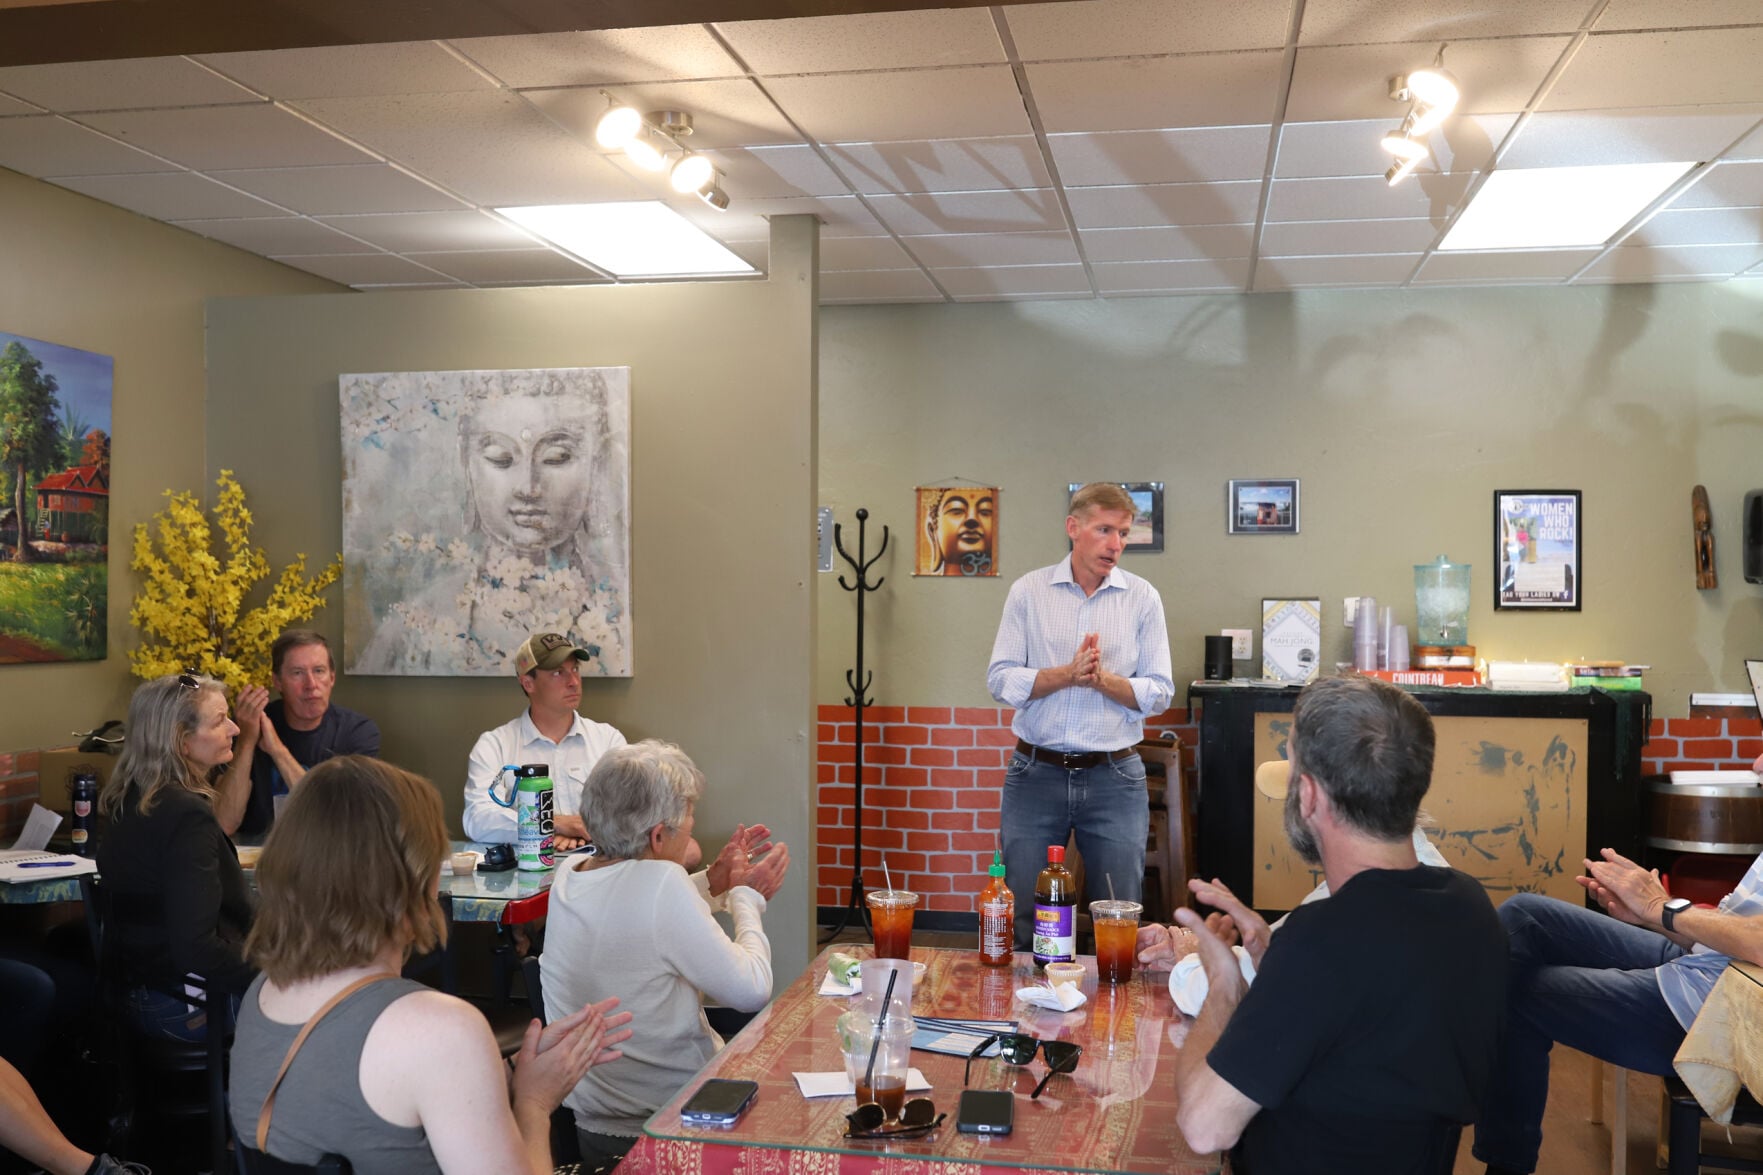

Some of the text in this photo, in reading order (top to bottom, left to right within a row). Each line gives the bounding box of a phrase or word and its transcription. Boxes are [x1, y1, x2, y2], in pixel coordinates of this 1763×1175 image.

[1530, 502, 1573, 515] WOMEN
[1543, 515, 1570, 528] WHO
[1540, 527, 1573, 541] ROCK!
[1290, 638, 1313, 646] JONG
[1392, 672, 1444, 686] COINTREAU
